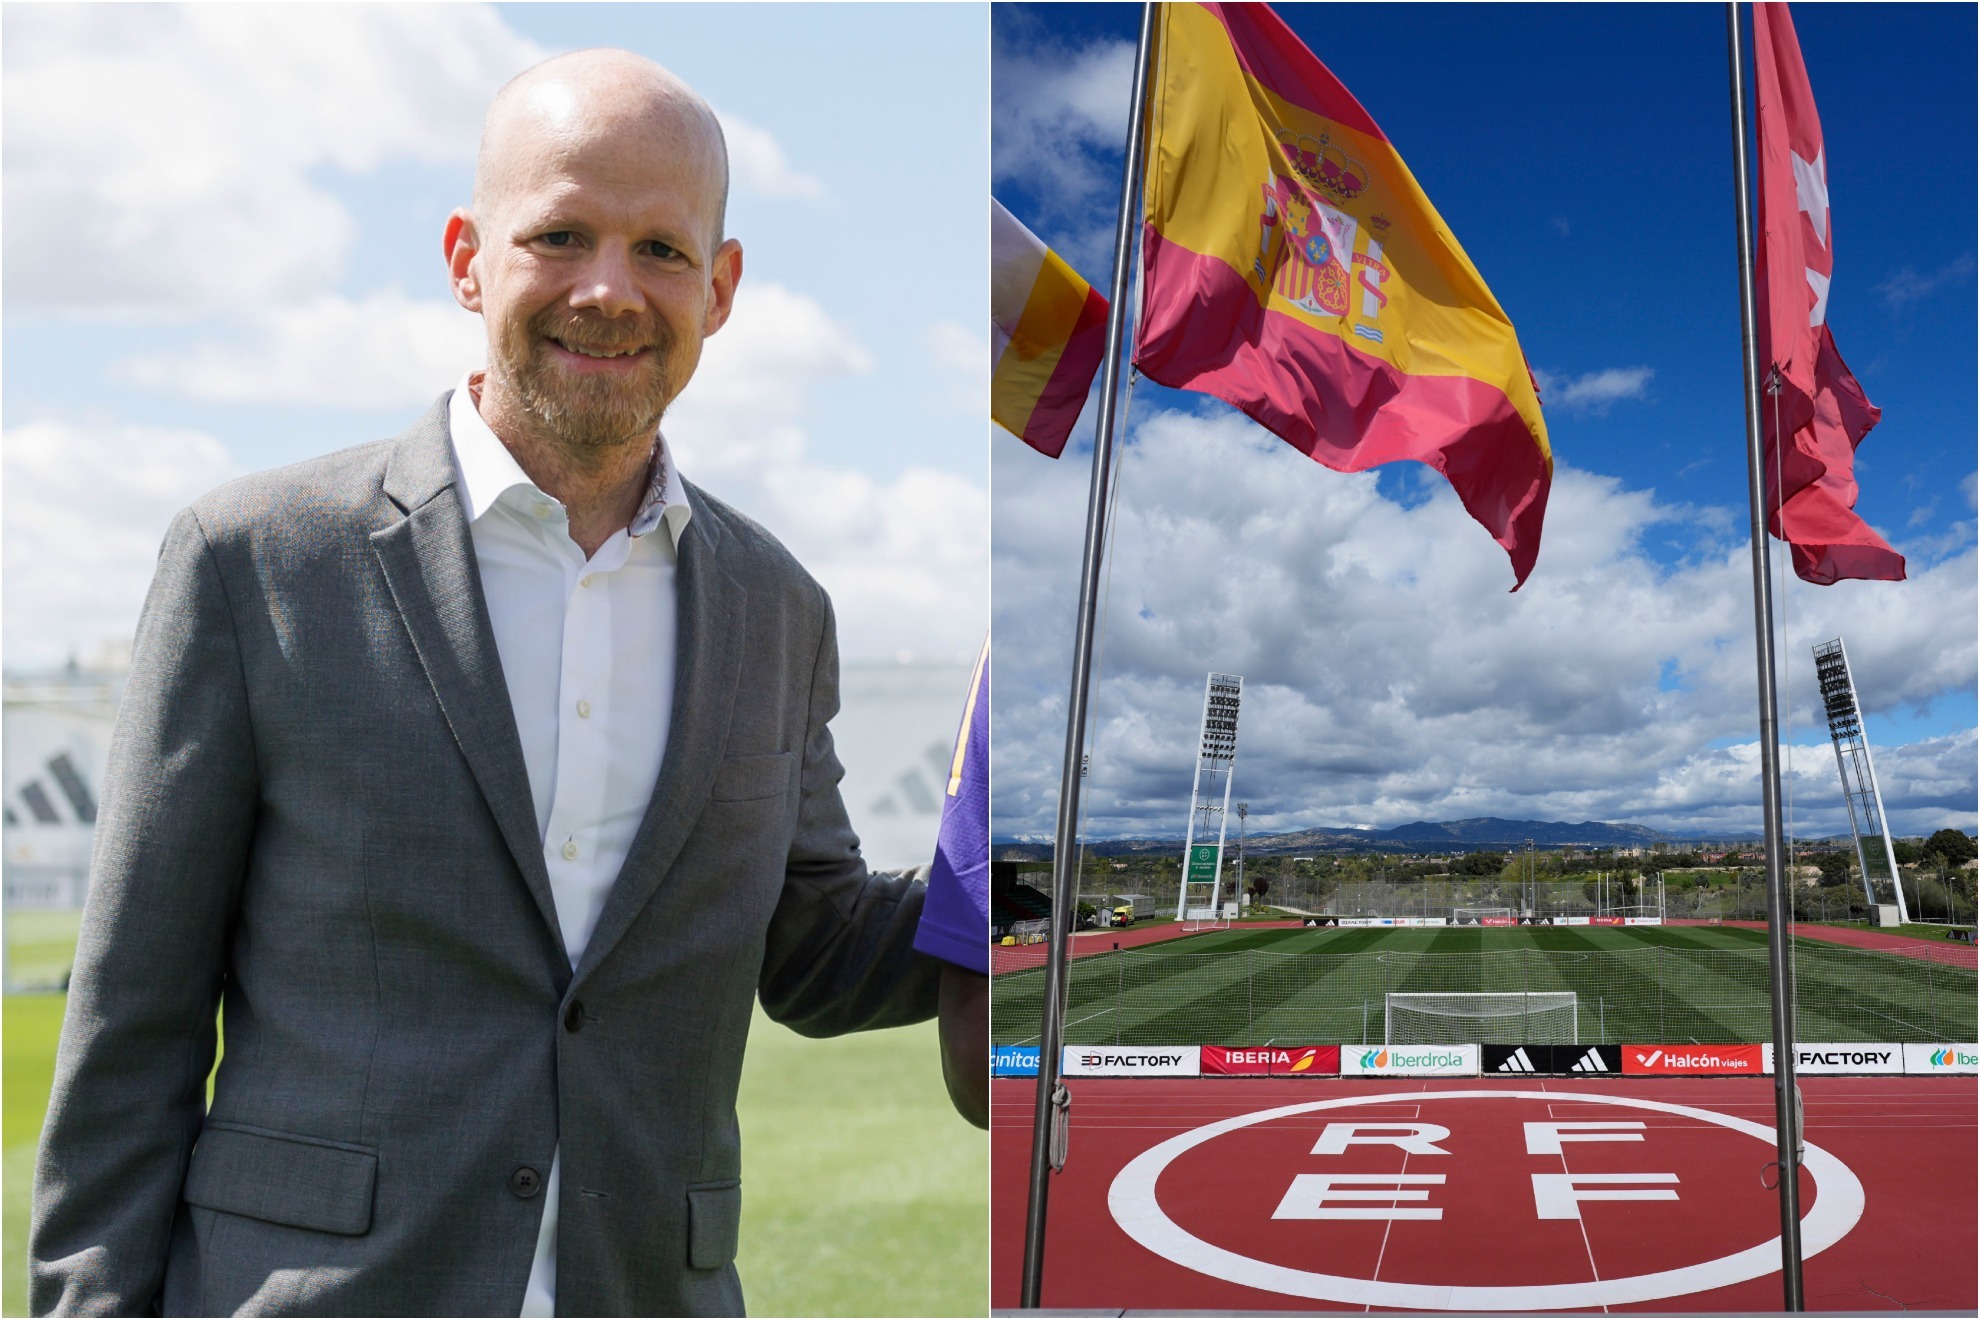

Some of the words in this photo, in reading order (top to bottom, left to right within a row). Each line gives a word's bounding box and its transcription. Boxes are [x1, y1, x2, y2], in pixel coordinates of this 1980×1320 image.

[1104, 1055, 1183, 1067] FACTORY
[1225, 1051, 1291, 1064] IBERIA
[1391, 1051, 1463, 1067] Iberdrola
[1664, 1053, 1720, 1068] Halcón
[1720, 1058, 1748, 1069] viajes
[1799, 1052, 1892, 1065] FACTORY
